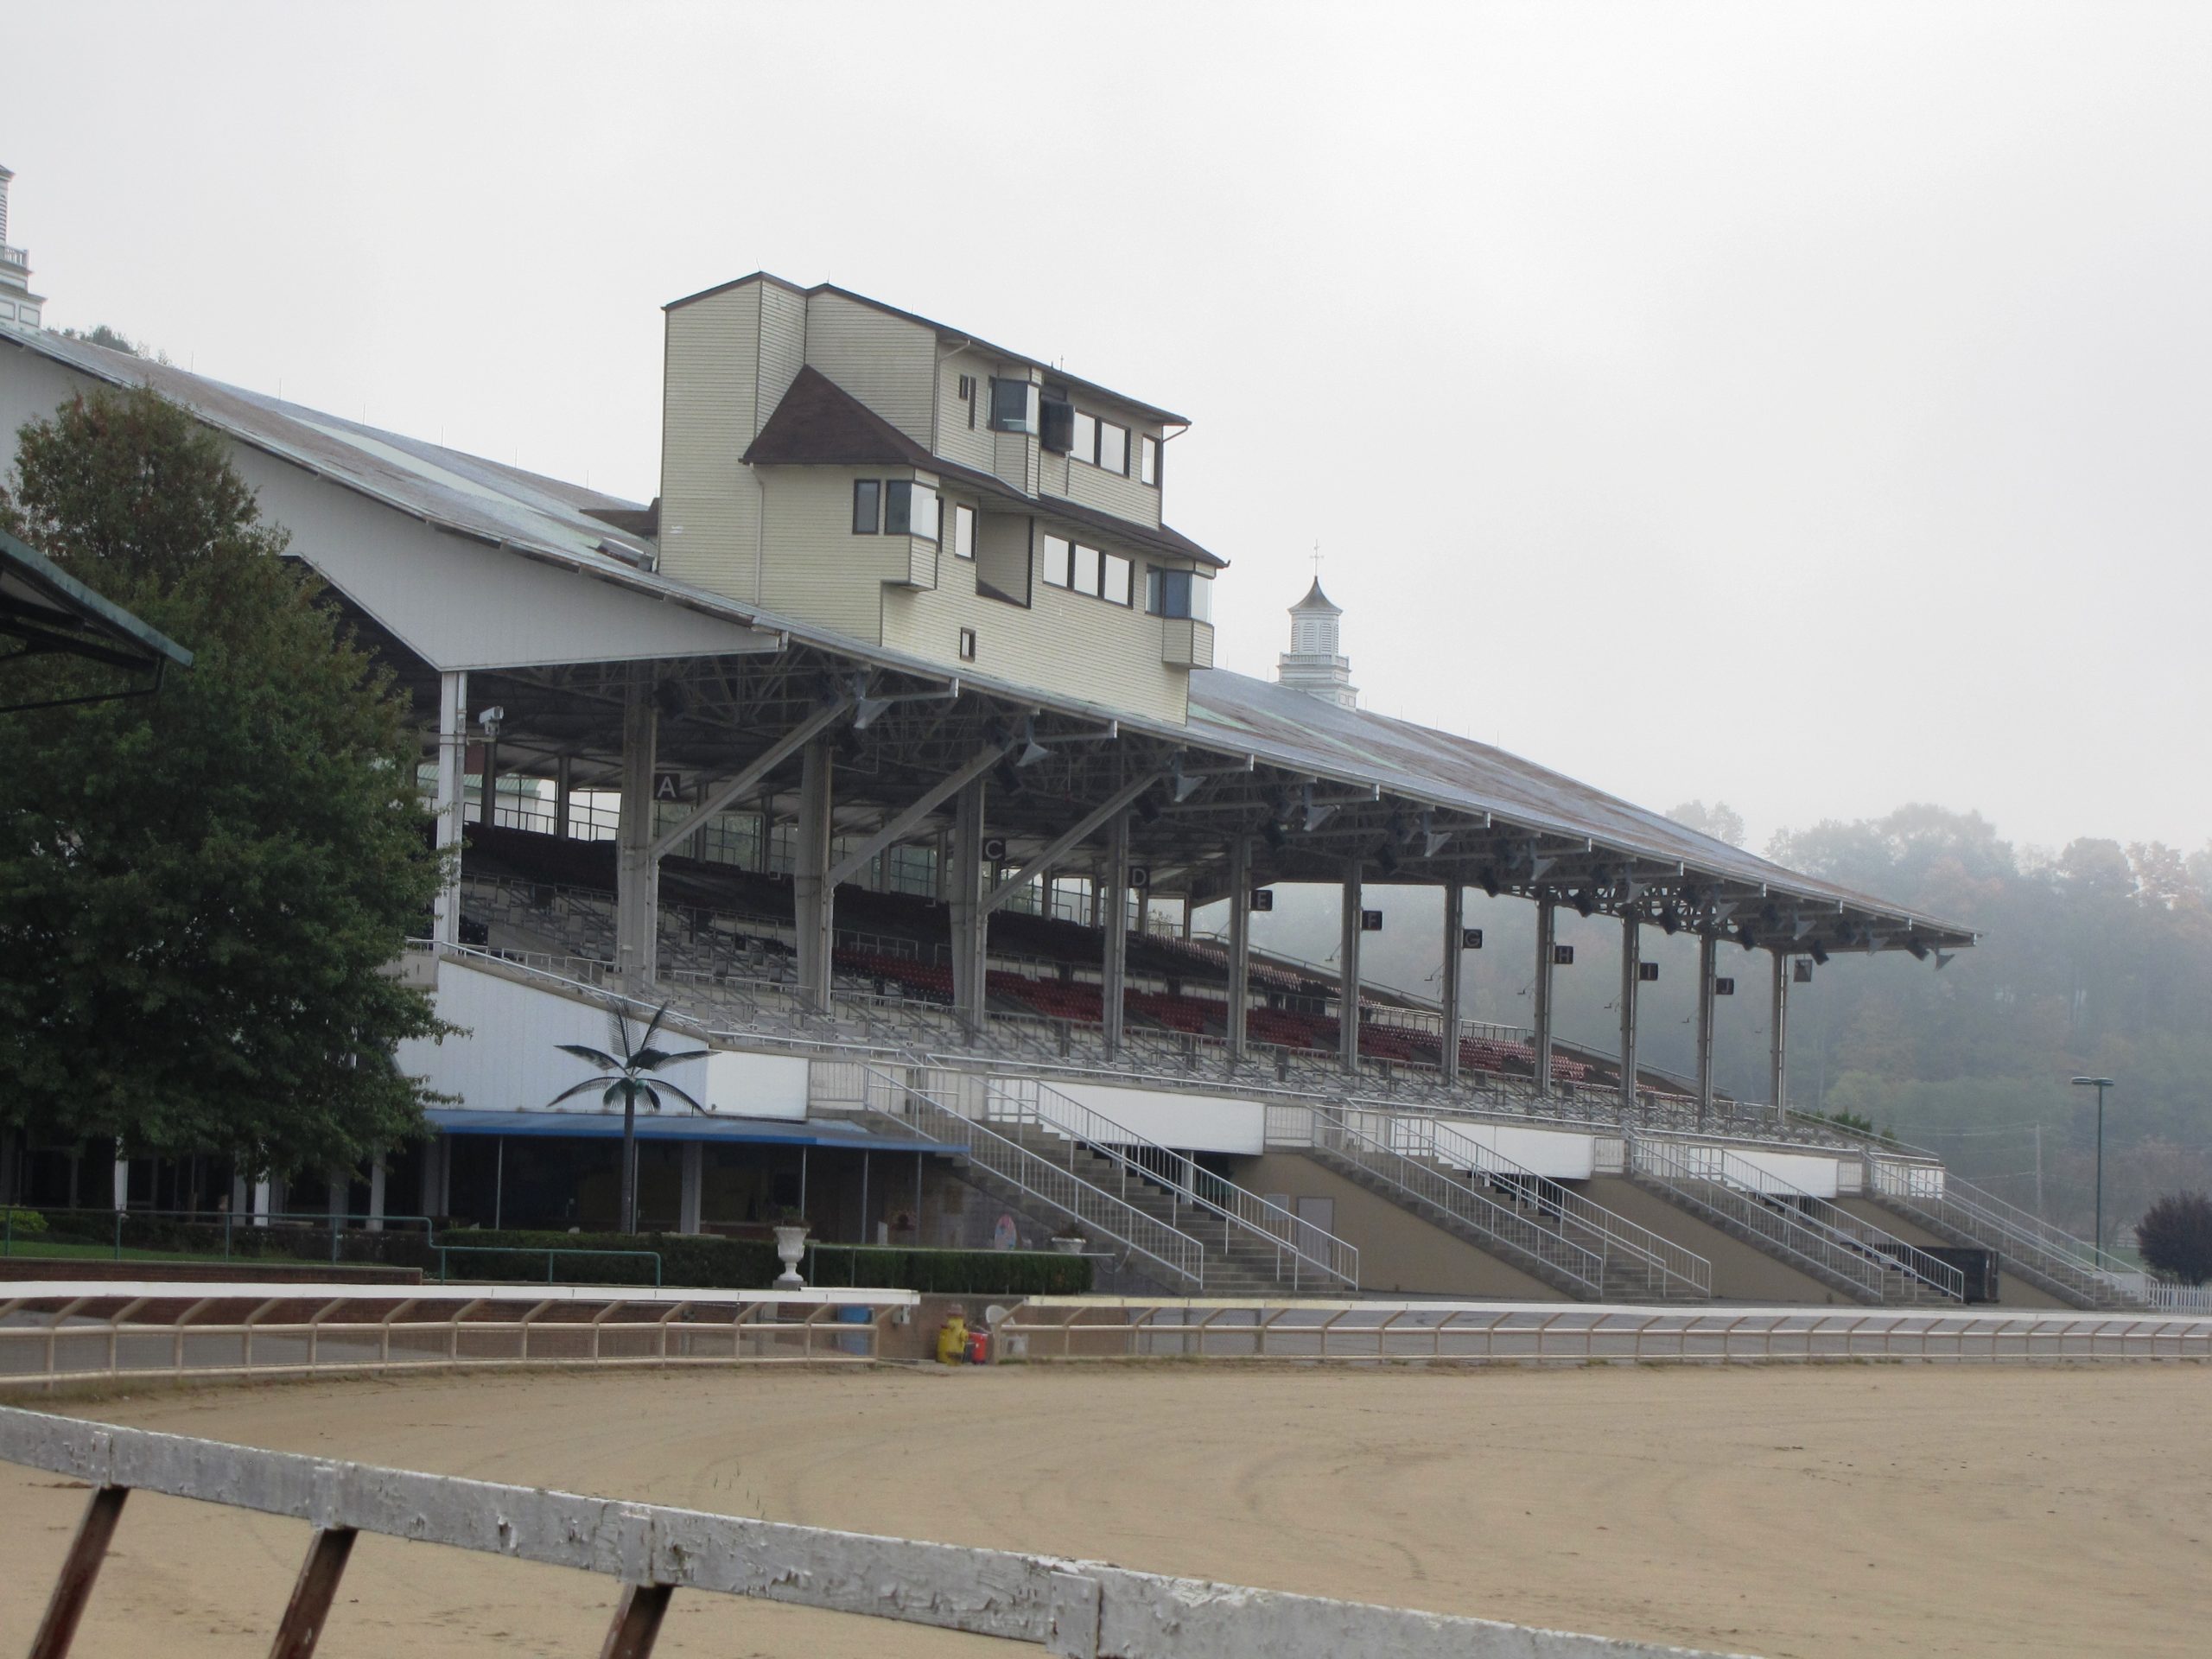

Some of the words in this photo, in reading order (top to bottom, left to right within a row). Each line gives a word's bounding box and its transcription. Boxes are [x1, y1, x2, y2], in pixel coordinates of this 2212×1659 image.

[658, 776, 677, 798] A
[986, 840, 1003, 859] C
[1132, 868, 1147, 886] D
[1257, 892, 1267, 909] E
[1368, 912, 1377, 929] F
[1465, 931, 1480, 947] G
[1559, 947, 1570, 962] H
